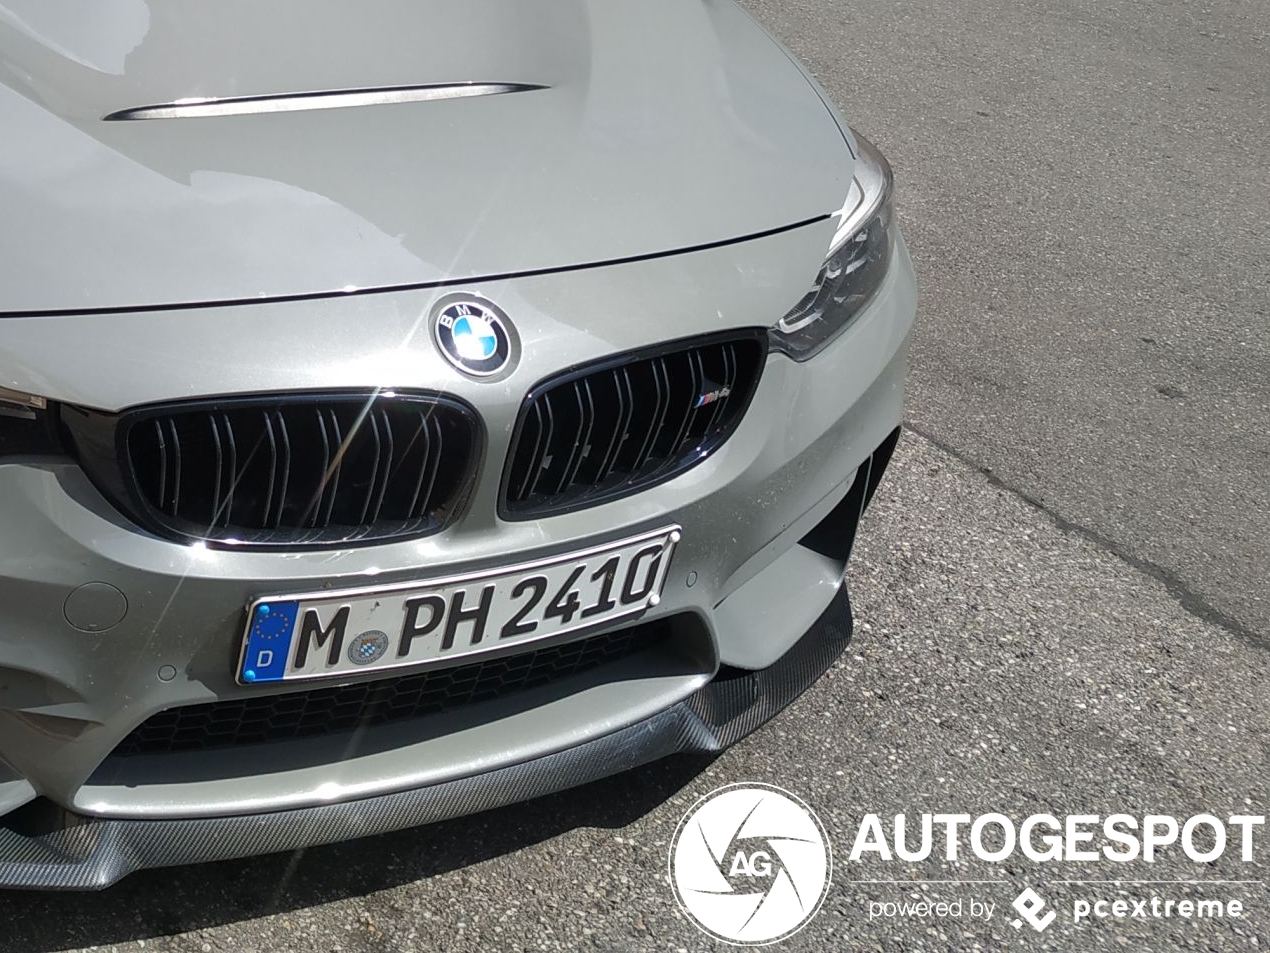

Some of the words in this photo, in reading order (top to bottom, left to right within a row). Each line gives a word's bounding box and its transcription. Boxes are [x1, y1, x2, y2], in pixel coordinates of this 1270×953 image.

[439, 304, 495, 329] BMW
[256, 650, 273, 668] D
[294, 605, 351, 669] M
[397, 585, 496, 657] PH
[499, 544, 663, 639] 2410
